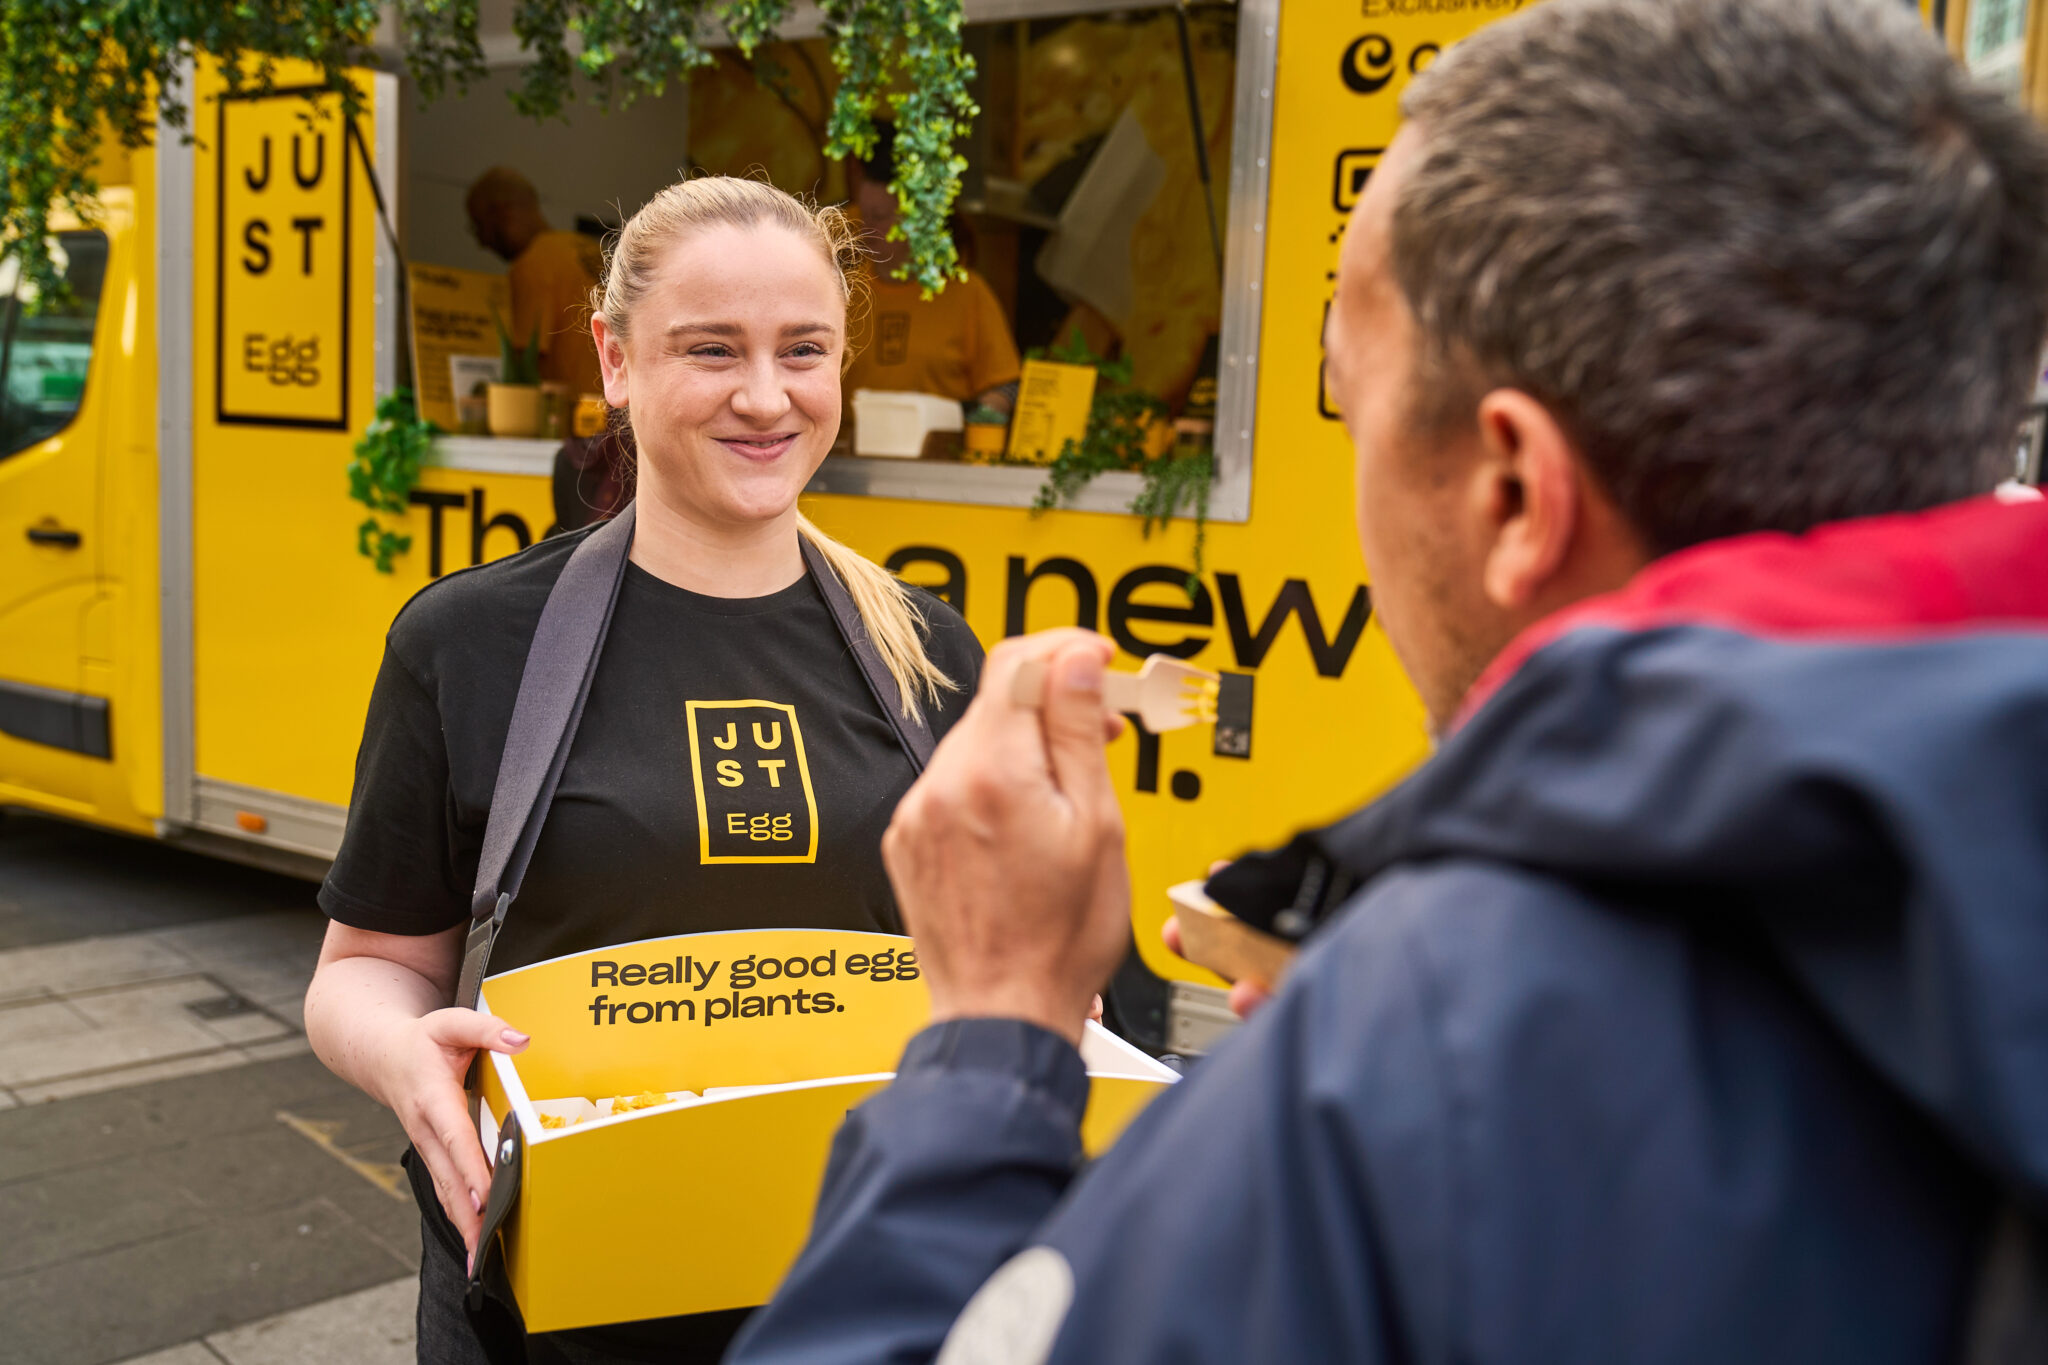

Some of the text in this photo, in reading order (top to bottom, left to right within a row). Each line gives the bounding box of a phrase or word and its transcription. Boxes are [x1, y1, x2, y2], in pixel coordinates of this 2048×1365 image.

[244, 333, 320, 386] Egg
[1005, 555, 1373, 680] new
[727, 812, 793, 841] Egg
[591, 956, 721, 991] Really
[729, 950, 836, 989] good
[589, 989, 845, 1027] from plants.
